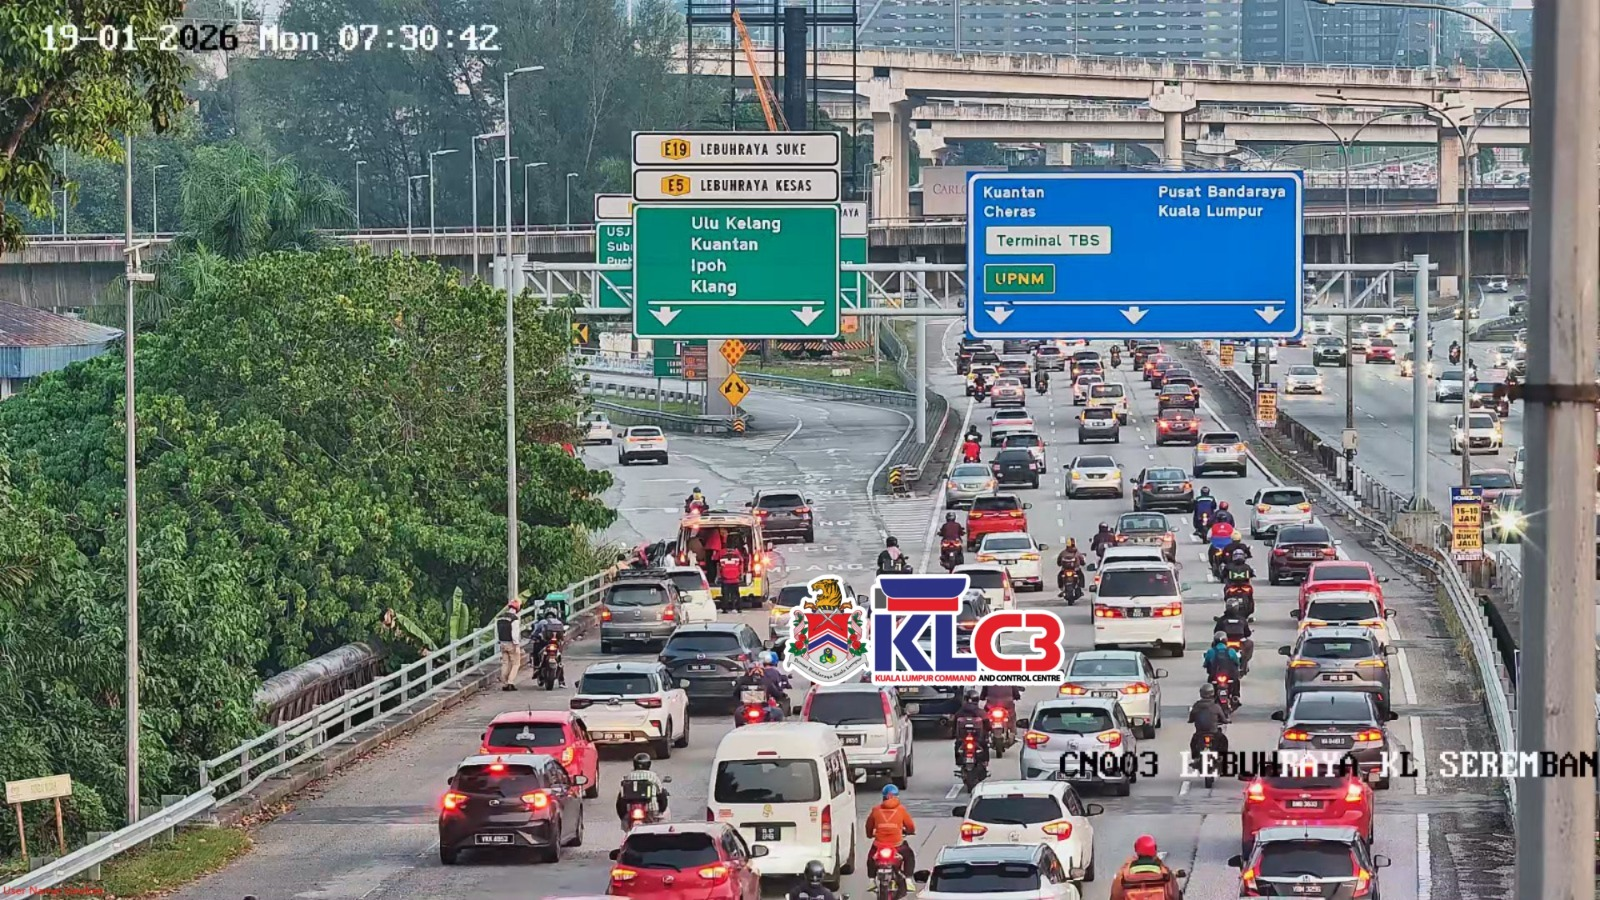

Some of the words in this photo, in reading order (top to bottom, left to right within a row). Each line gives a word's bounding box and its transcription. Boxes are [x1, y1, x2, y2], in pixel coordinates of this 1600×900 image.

[664, 142, 687, 156] E19
[700, 143, 769, 156] LEBUHRAYA
[776, 143, 807, 156] SUKE
[668, 178, 684, 192] E5
[700, 179, 769, 192] LEBUHRAYA
[775, 179, 812, 192] KESAS
[1158, 185, 1202, 198] Pusat
[1207, 184, 1286, 200] Bandaraya
[983, 186, 1045, 199] Kuantan
[983, 205, 1037, 218] Cheras
[1158, 204, 1201, 217] Kuala
[1206, 204, 1263, 220] Lumpur
[606, 226, 631, 237] USJ
[691, 216, 719, 230] Ulu
[726, 216, 781, 233] Kelang
[691, 237, 759, 251] Kuantan
[996, 234, 1062, 247] Terminal
[1068, 234, 1100, 246] TBS
[691, 258, 727, 275] Ipoh
[995, 272, 1045, 285] UPNM
[691, 279, 737, 297] Klang
